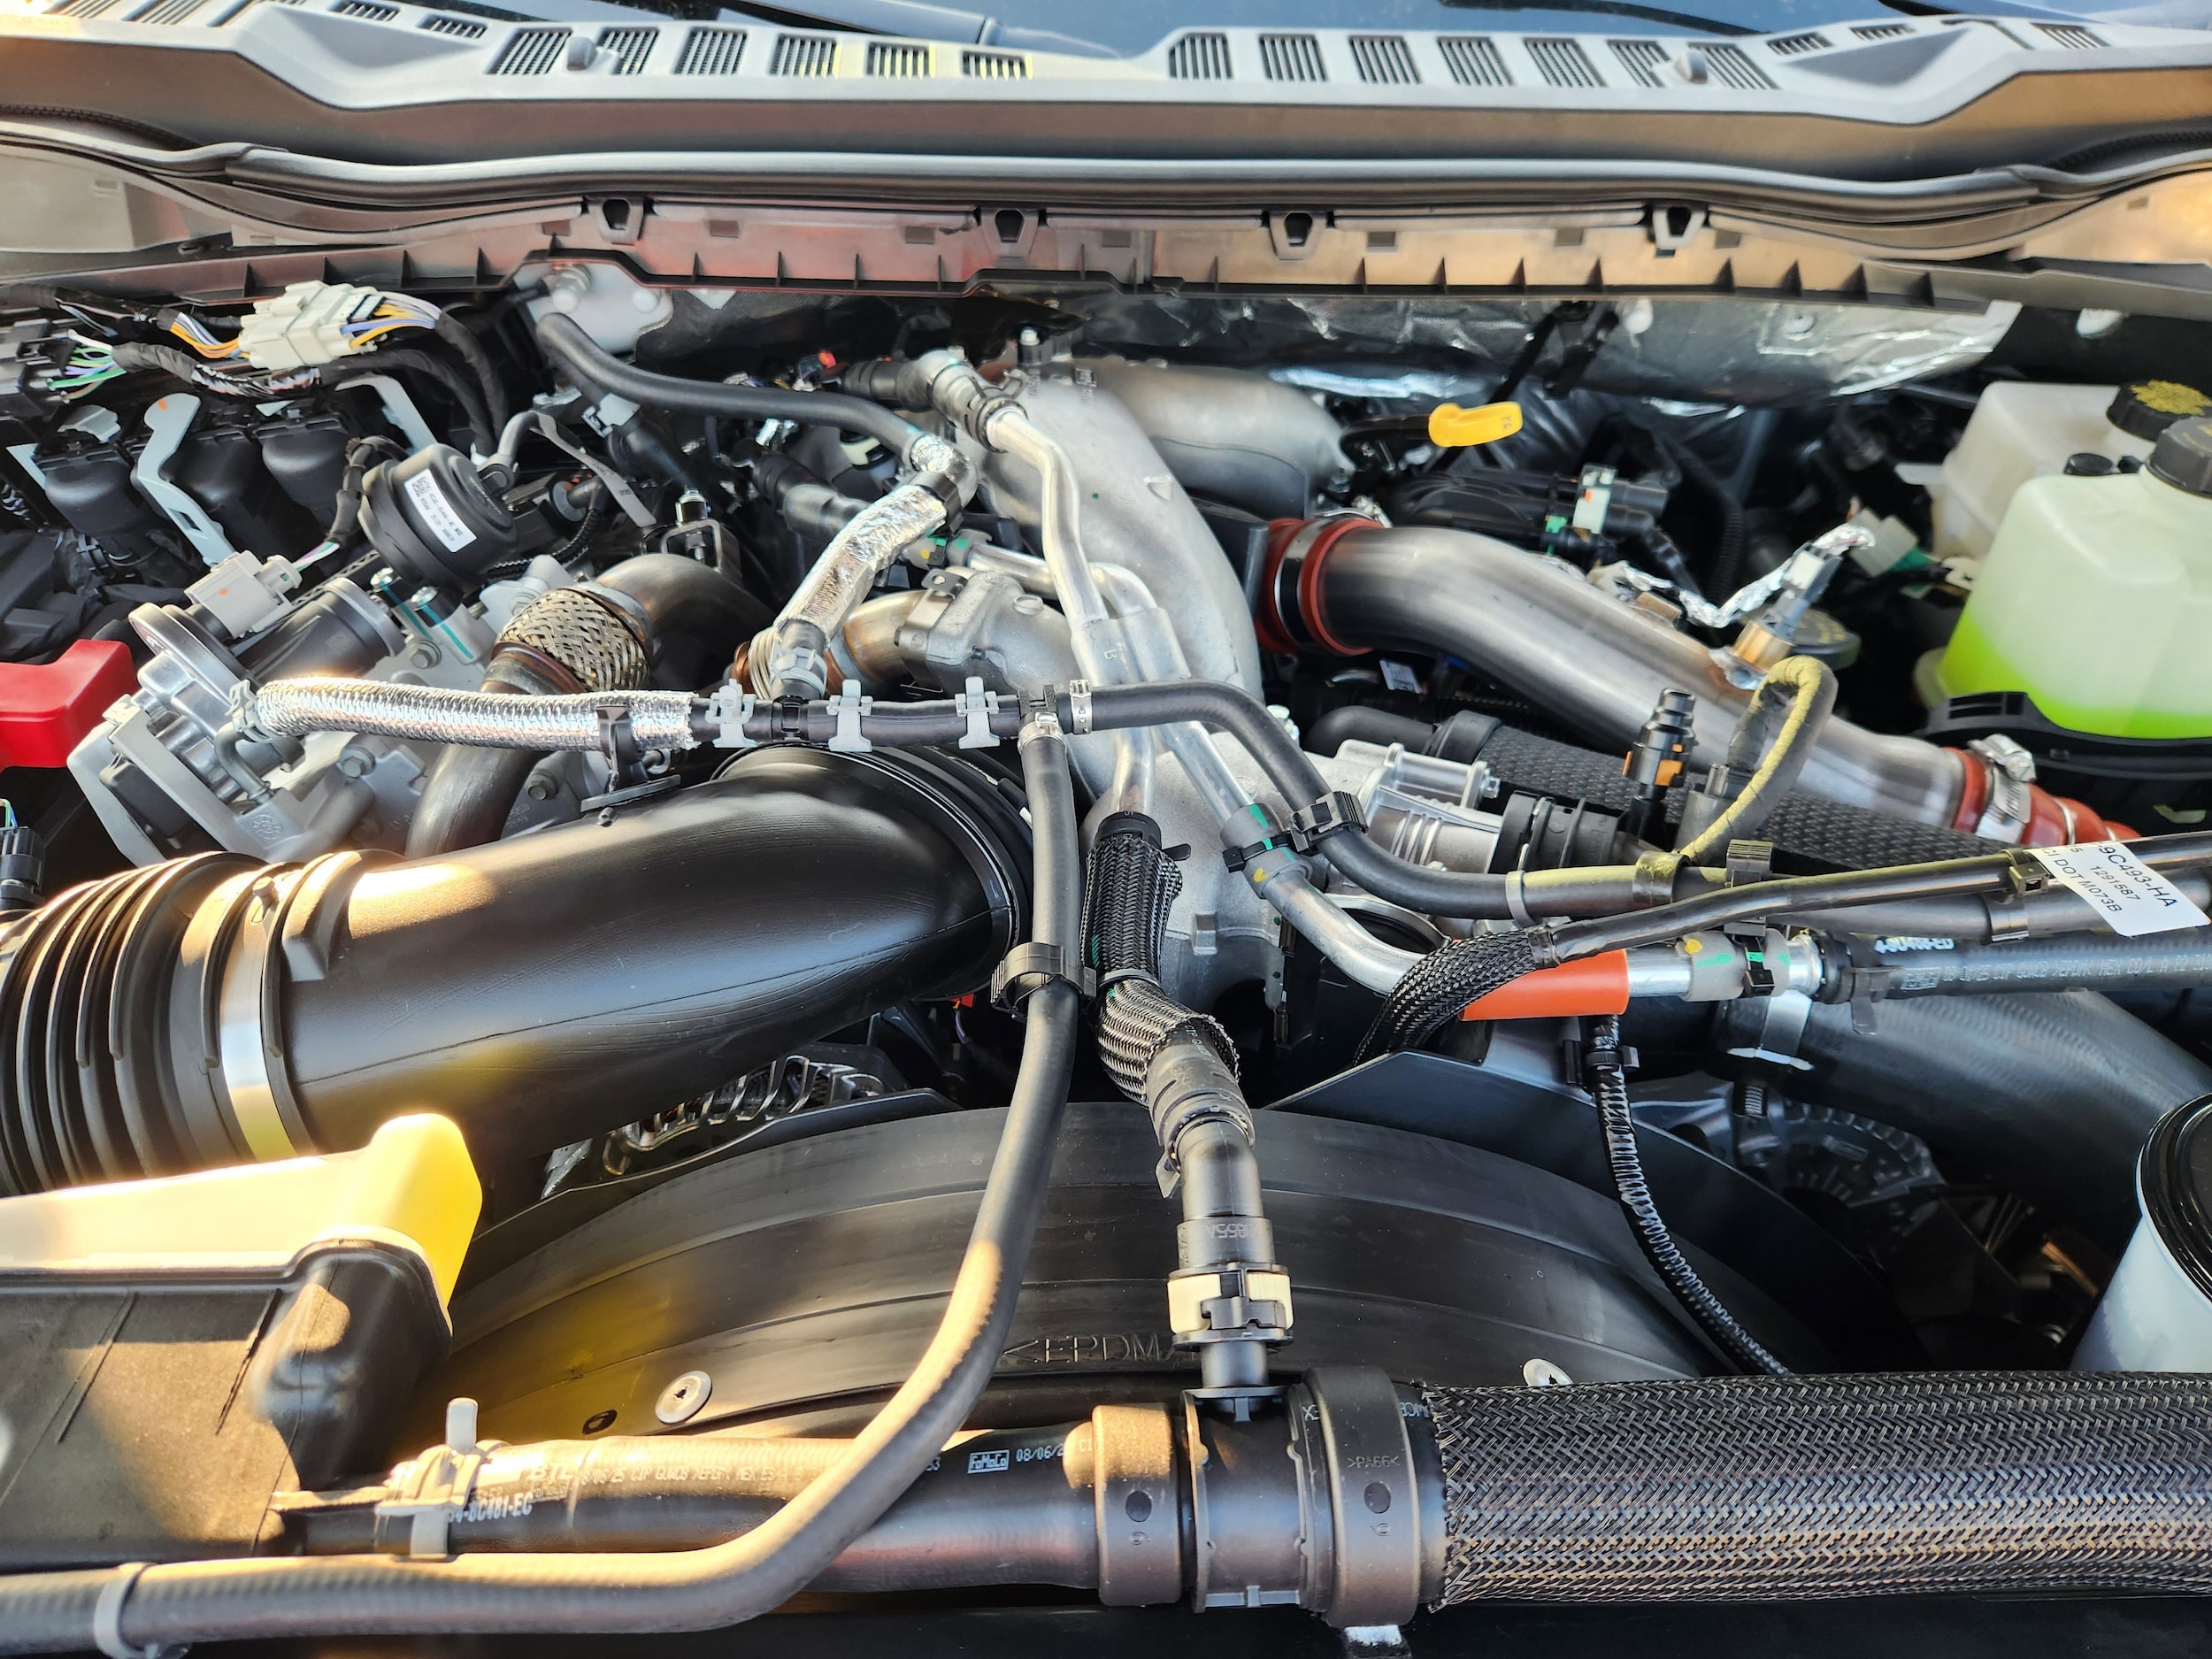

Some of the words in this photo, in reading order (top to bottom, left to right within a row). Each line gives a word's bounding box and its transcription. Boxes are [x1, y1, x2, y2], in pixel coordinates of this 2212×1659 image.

[2054, 858, 2085, 879] DOT
[2079, 880, 2123, 913] M073B
[2089, 865, 2141, 901] 1291587
